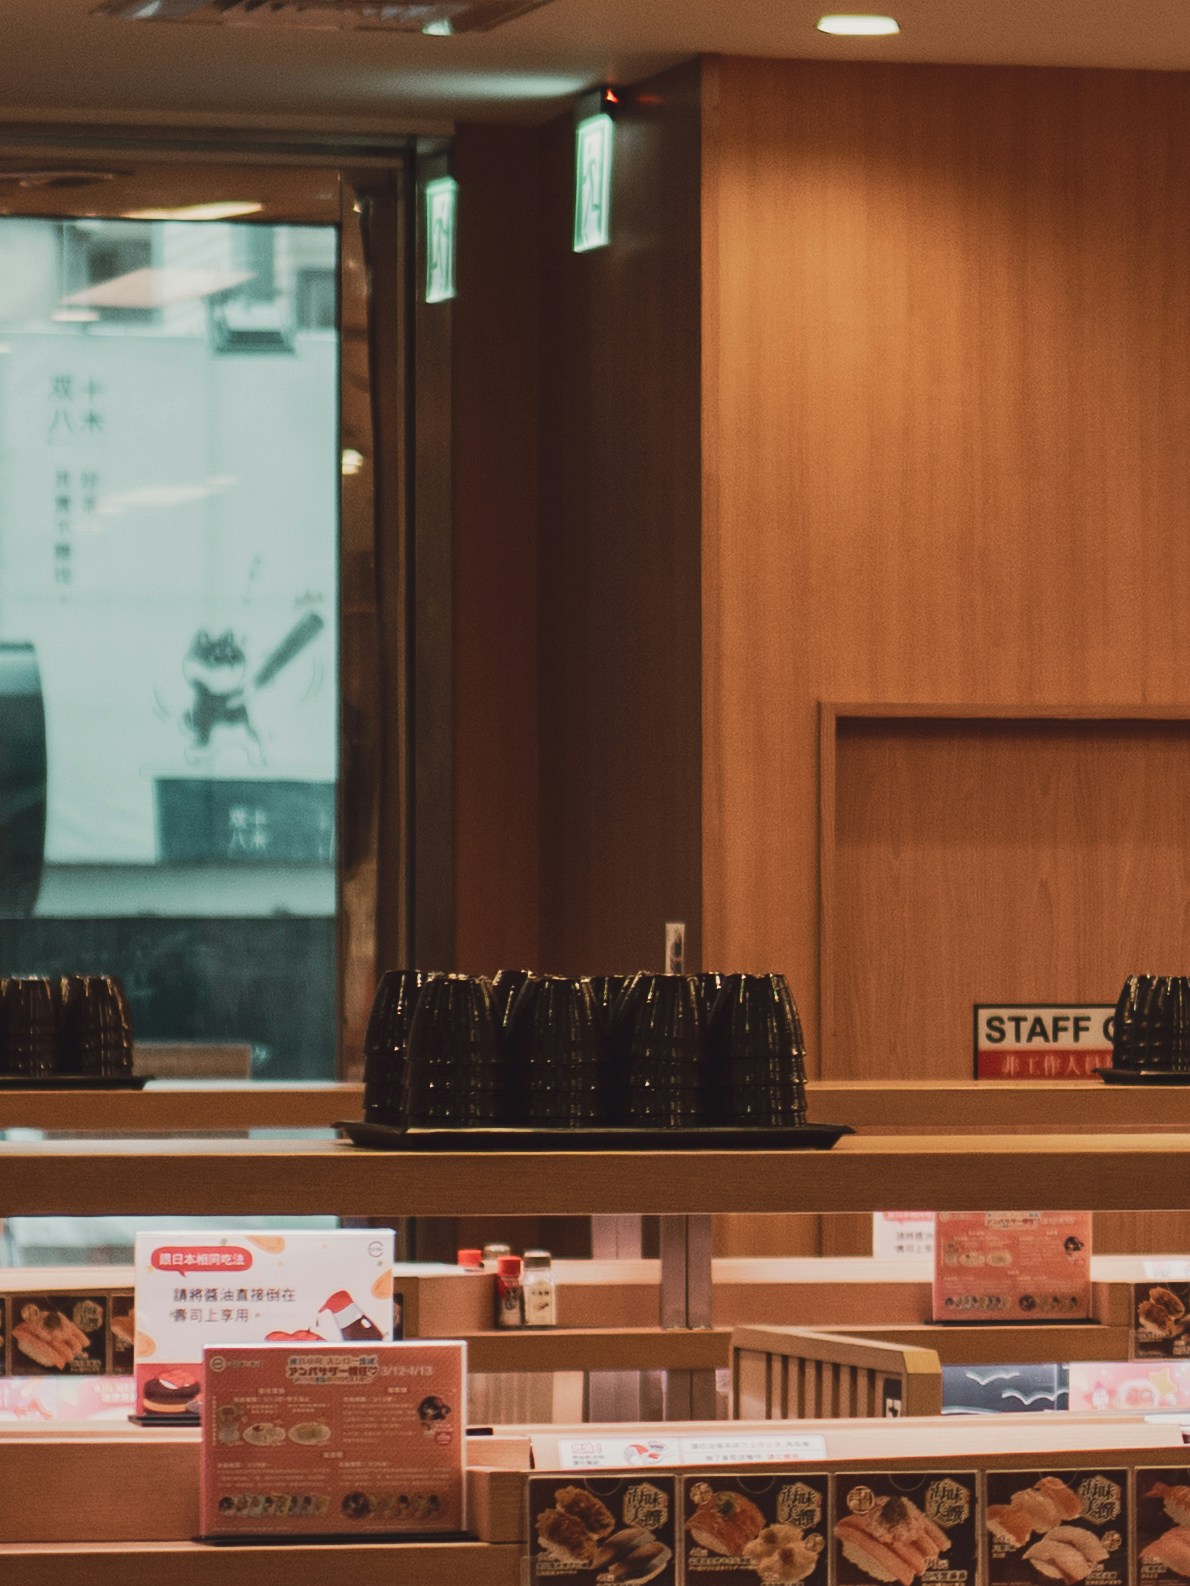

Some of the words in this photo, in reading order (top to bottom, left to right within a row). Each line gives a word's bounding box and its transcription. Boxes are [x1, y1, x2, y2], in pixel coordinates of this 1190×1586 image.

[985, 1015, 1092, 1044] STAFF
[173, 1288, 296, 1303] 請將醬油直接倒在
